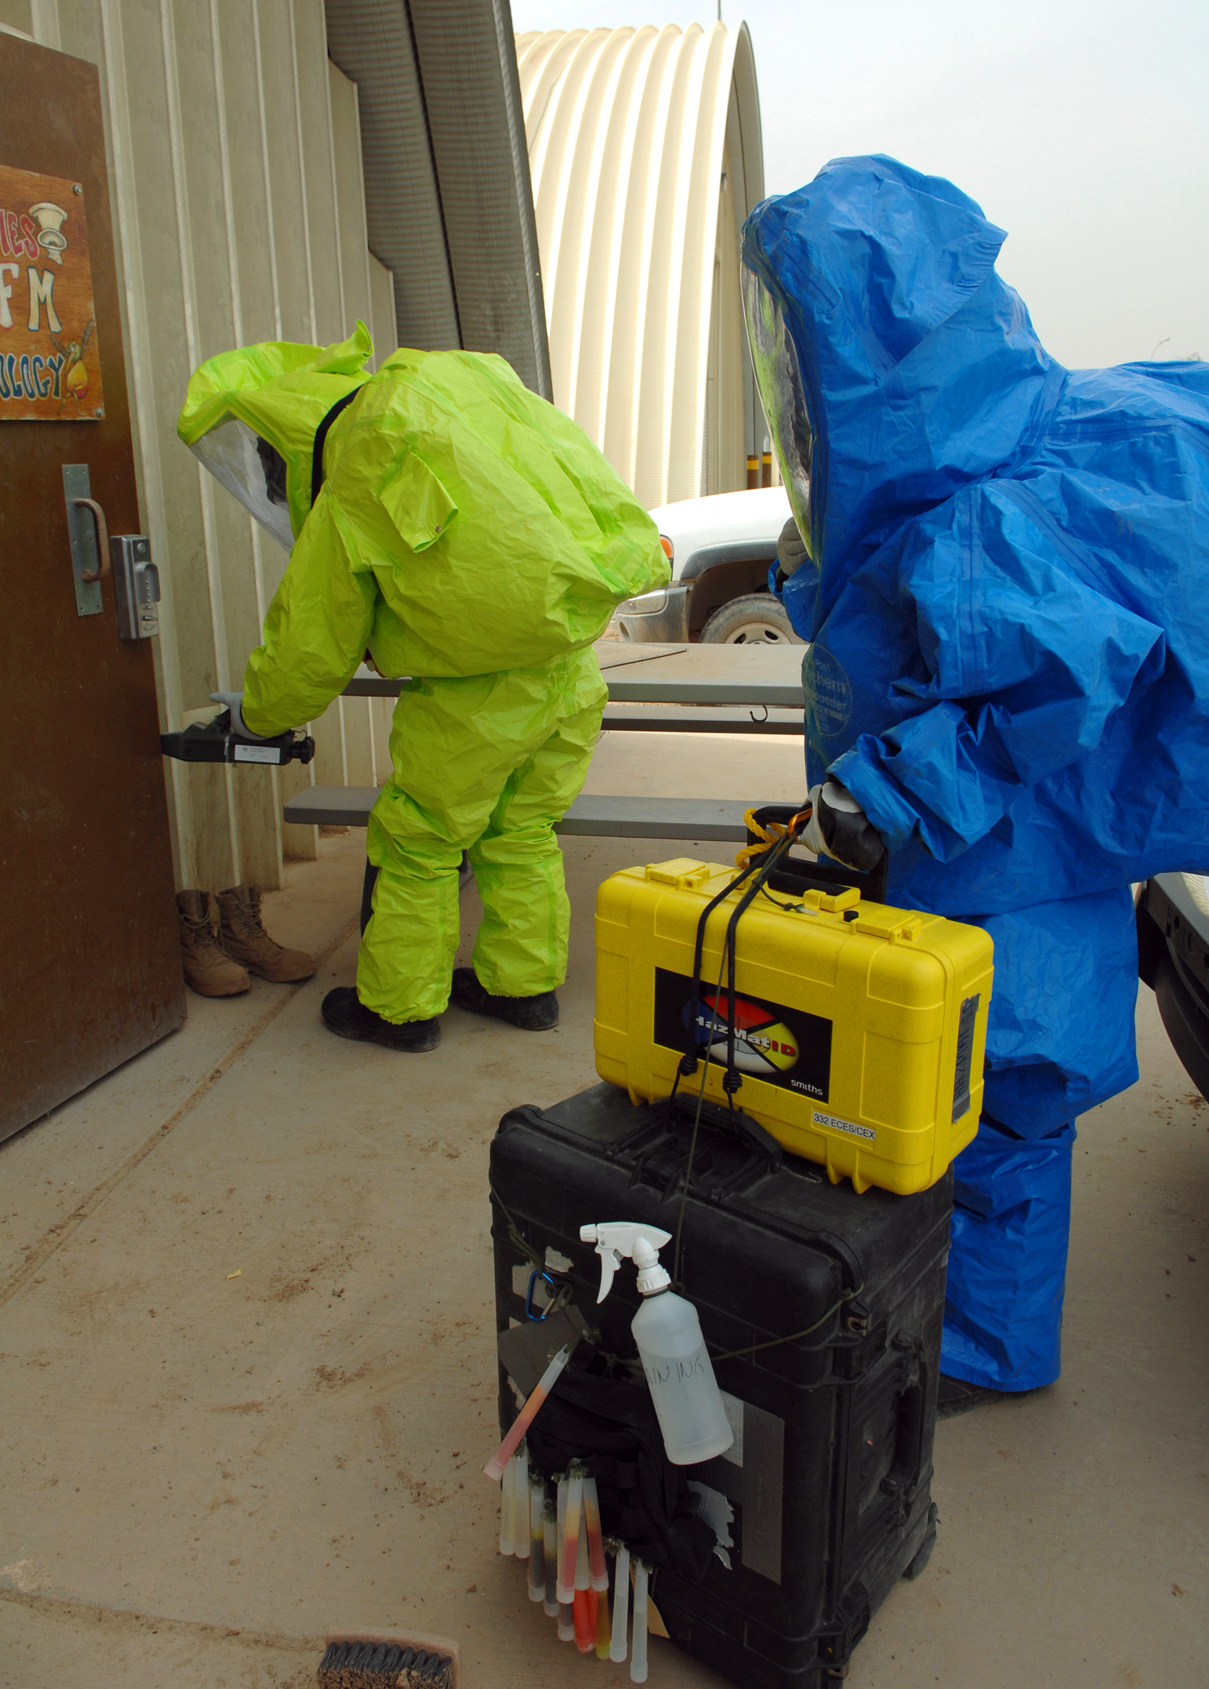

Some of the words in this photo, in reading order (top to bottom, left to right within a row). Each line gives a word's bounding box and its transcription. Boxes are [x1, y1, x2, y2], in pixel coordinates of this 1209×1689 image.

[790, 1079, 824, 1096] smiths
[813, 1113, 829, 1126] 332
[830, 1118, 876, 1140] ECES/CEX
